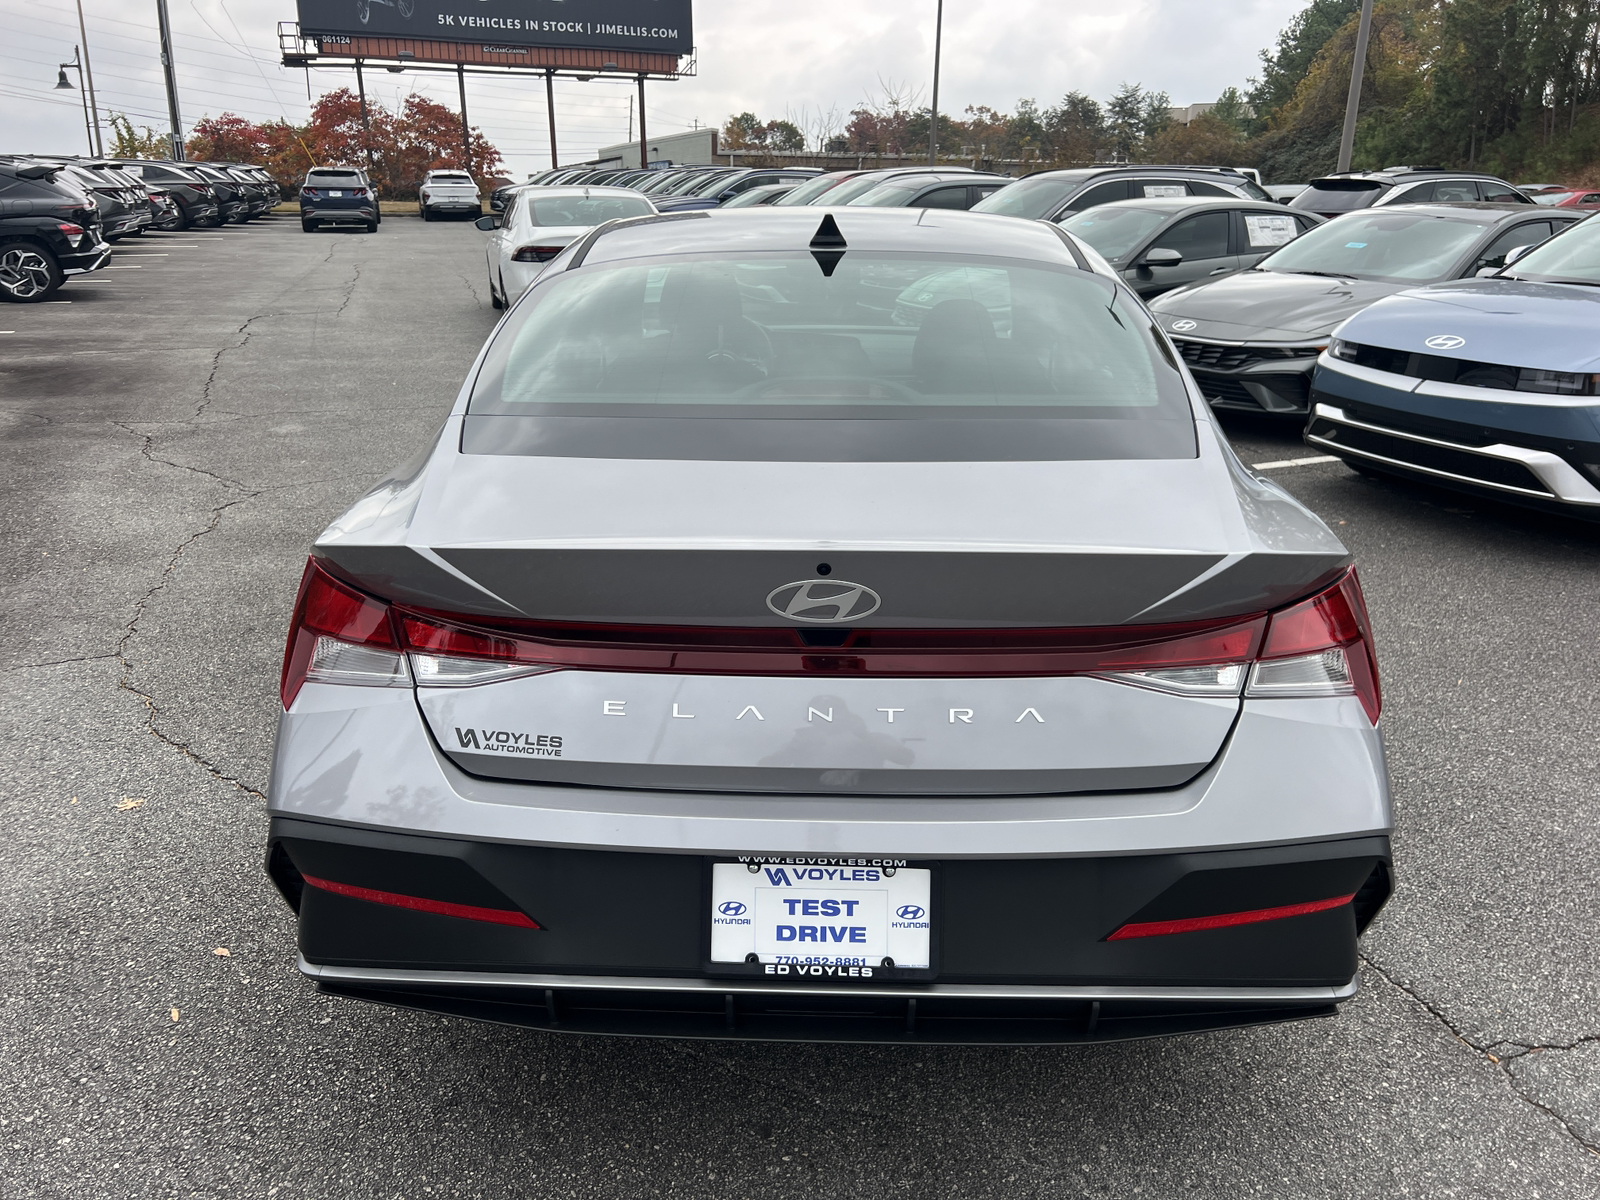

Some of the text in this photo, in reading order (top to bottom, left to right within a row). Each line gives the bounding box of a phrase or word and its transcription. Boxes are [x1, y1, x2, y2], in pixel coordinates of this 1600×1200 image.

[438, 14, 455, 26] 5K
[459, 16, 521, 29] VEHICLES
[525, 20, 539, 31] IN
[543, 21, 583, 33] STOCK
[595, 24, 678, 39] JIMELLIS.COM
[603, 699, 1046, 725] ELANTRA
[482, 729, 563, 748] VOYLES
[483, 743, 562, 757] AUTOMOTIVE
[738, 855, 907, 867] WWW.EDVOYLES.COM
[793, 868, 880, 882] VOYLES
[783, 899, 859, 917] TEST
[776, 925, 867, 944] DRIVE
[775, 956, 867, 967] 770-952-8881
[765, 965, 873, 977] ED VOYLES
